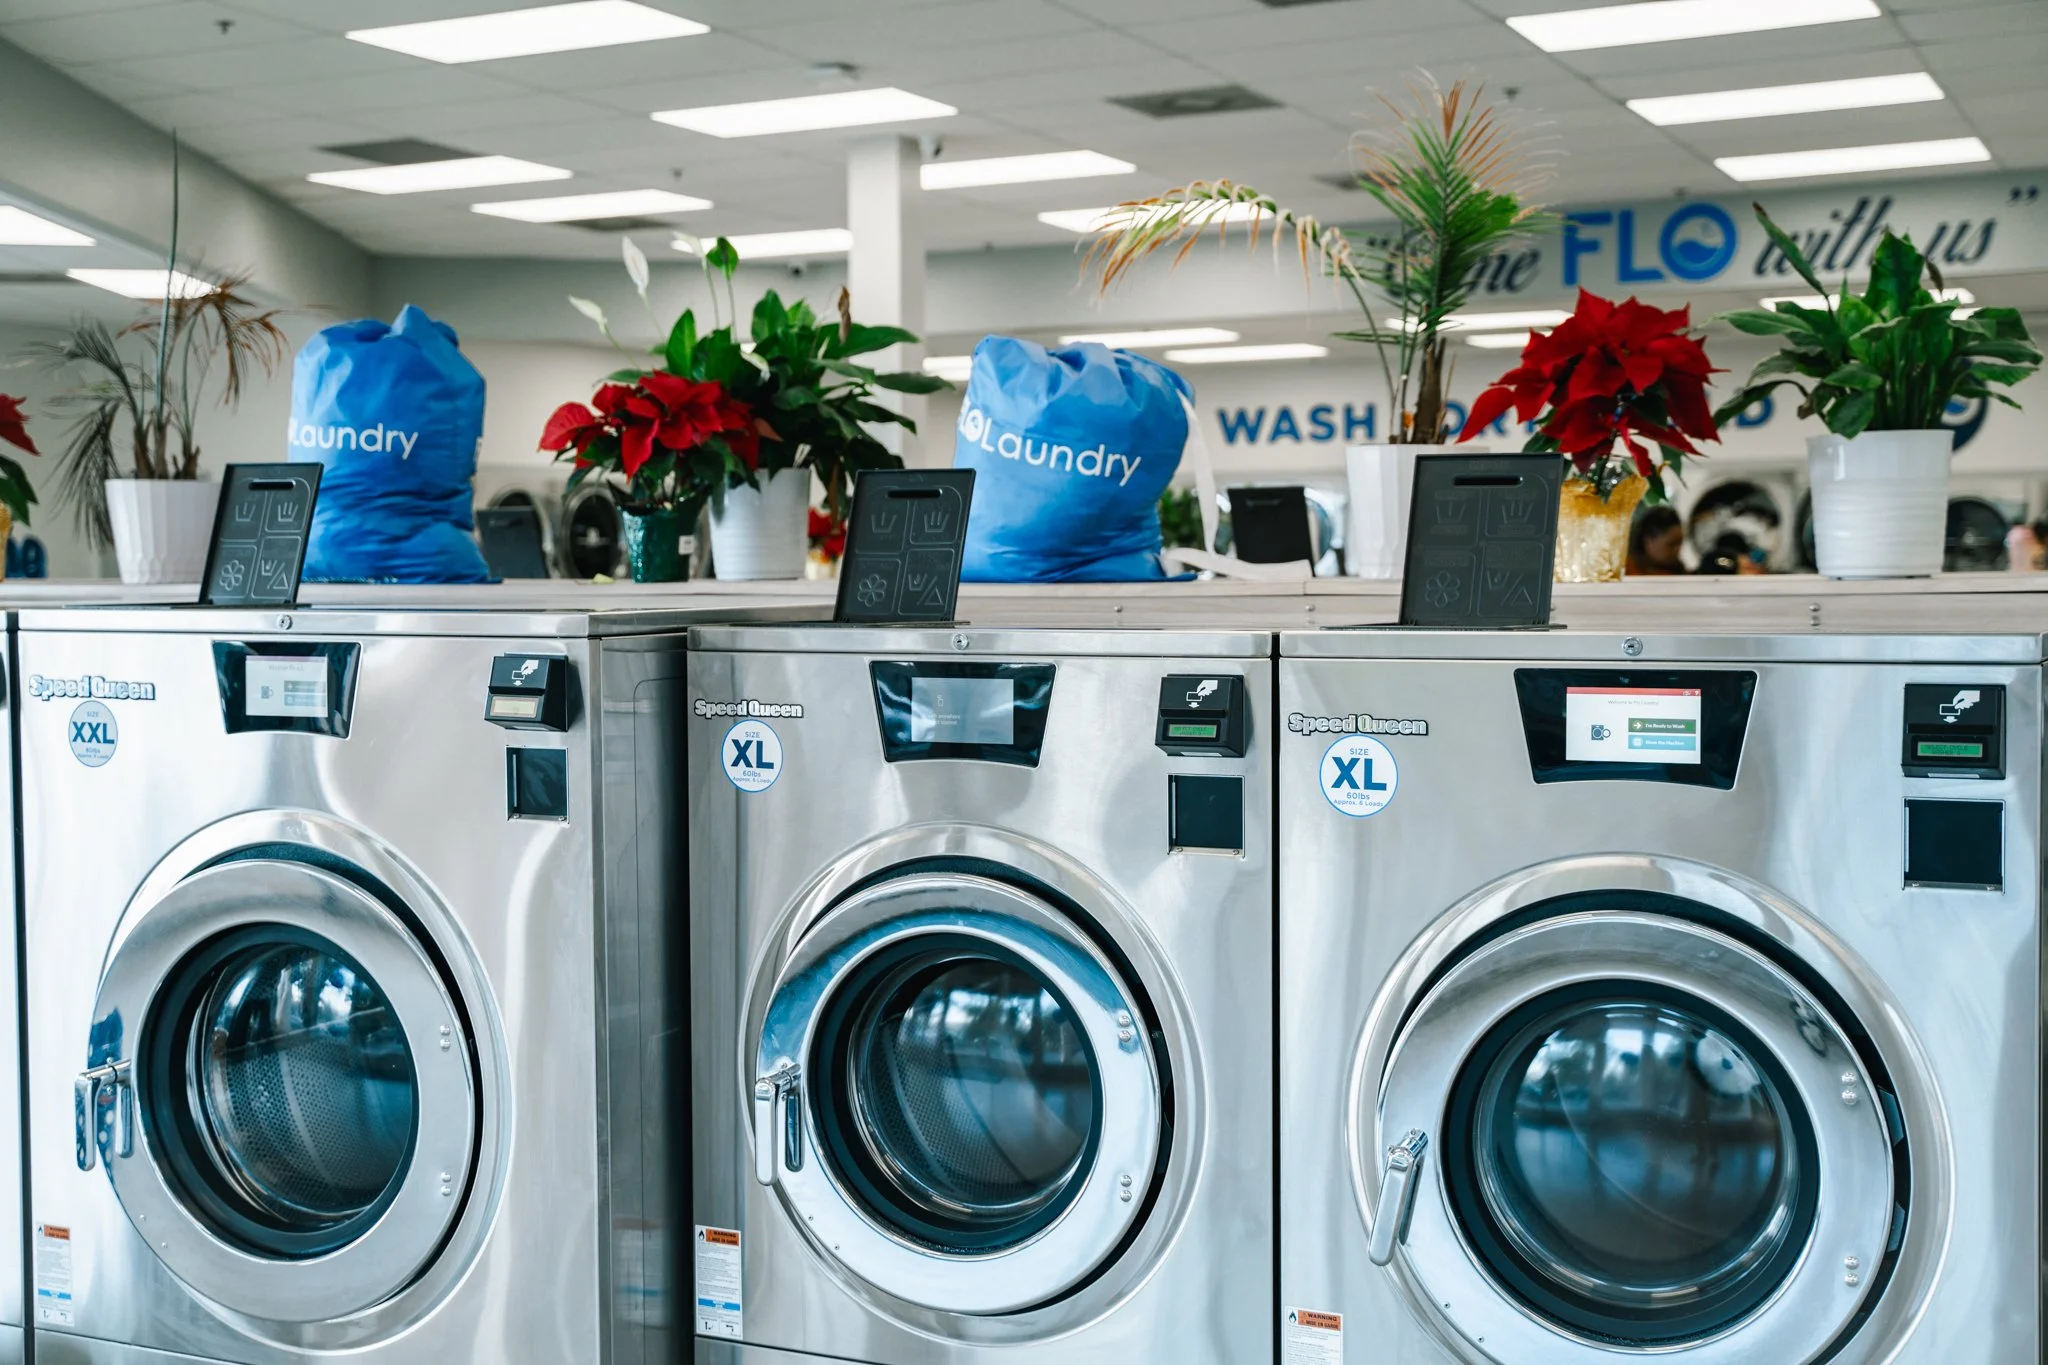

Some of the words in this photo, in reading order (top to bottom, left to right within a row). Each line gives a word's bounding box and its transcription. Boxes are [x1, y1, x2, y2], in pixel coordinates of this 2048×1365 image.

[1563, 203, 1738, 286] FLO
[1216, 403, 1377, 445] WASH
[29, 675, 91, 701] Speed
[91, 676, 155, 701] Queen
[694, 698, 748, 719] Speed
[748, 699, 804, 718] Queen
[72, 721, 115, 744] XXL
[1288, 712, 1357, 736] Speed
[1357, 713, 1428, 736] Queen
[730, 738, 775, 770] XL
[1349, 748, 1369, 756] SIZE
[742, 770, 761, 778] 60lbs
[1330, 756, 1388, 791] XL
[1346, 792, 1370, 801] 60lbs
[1308, 1312, 1337, 1321] WARNING
